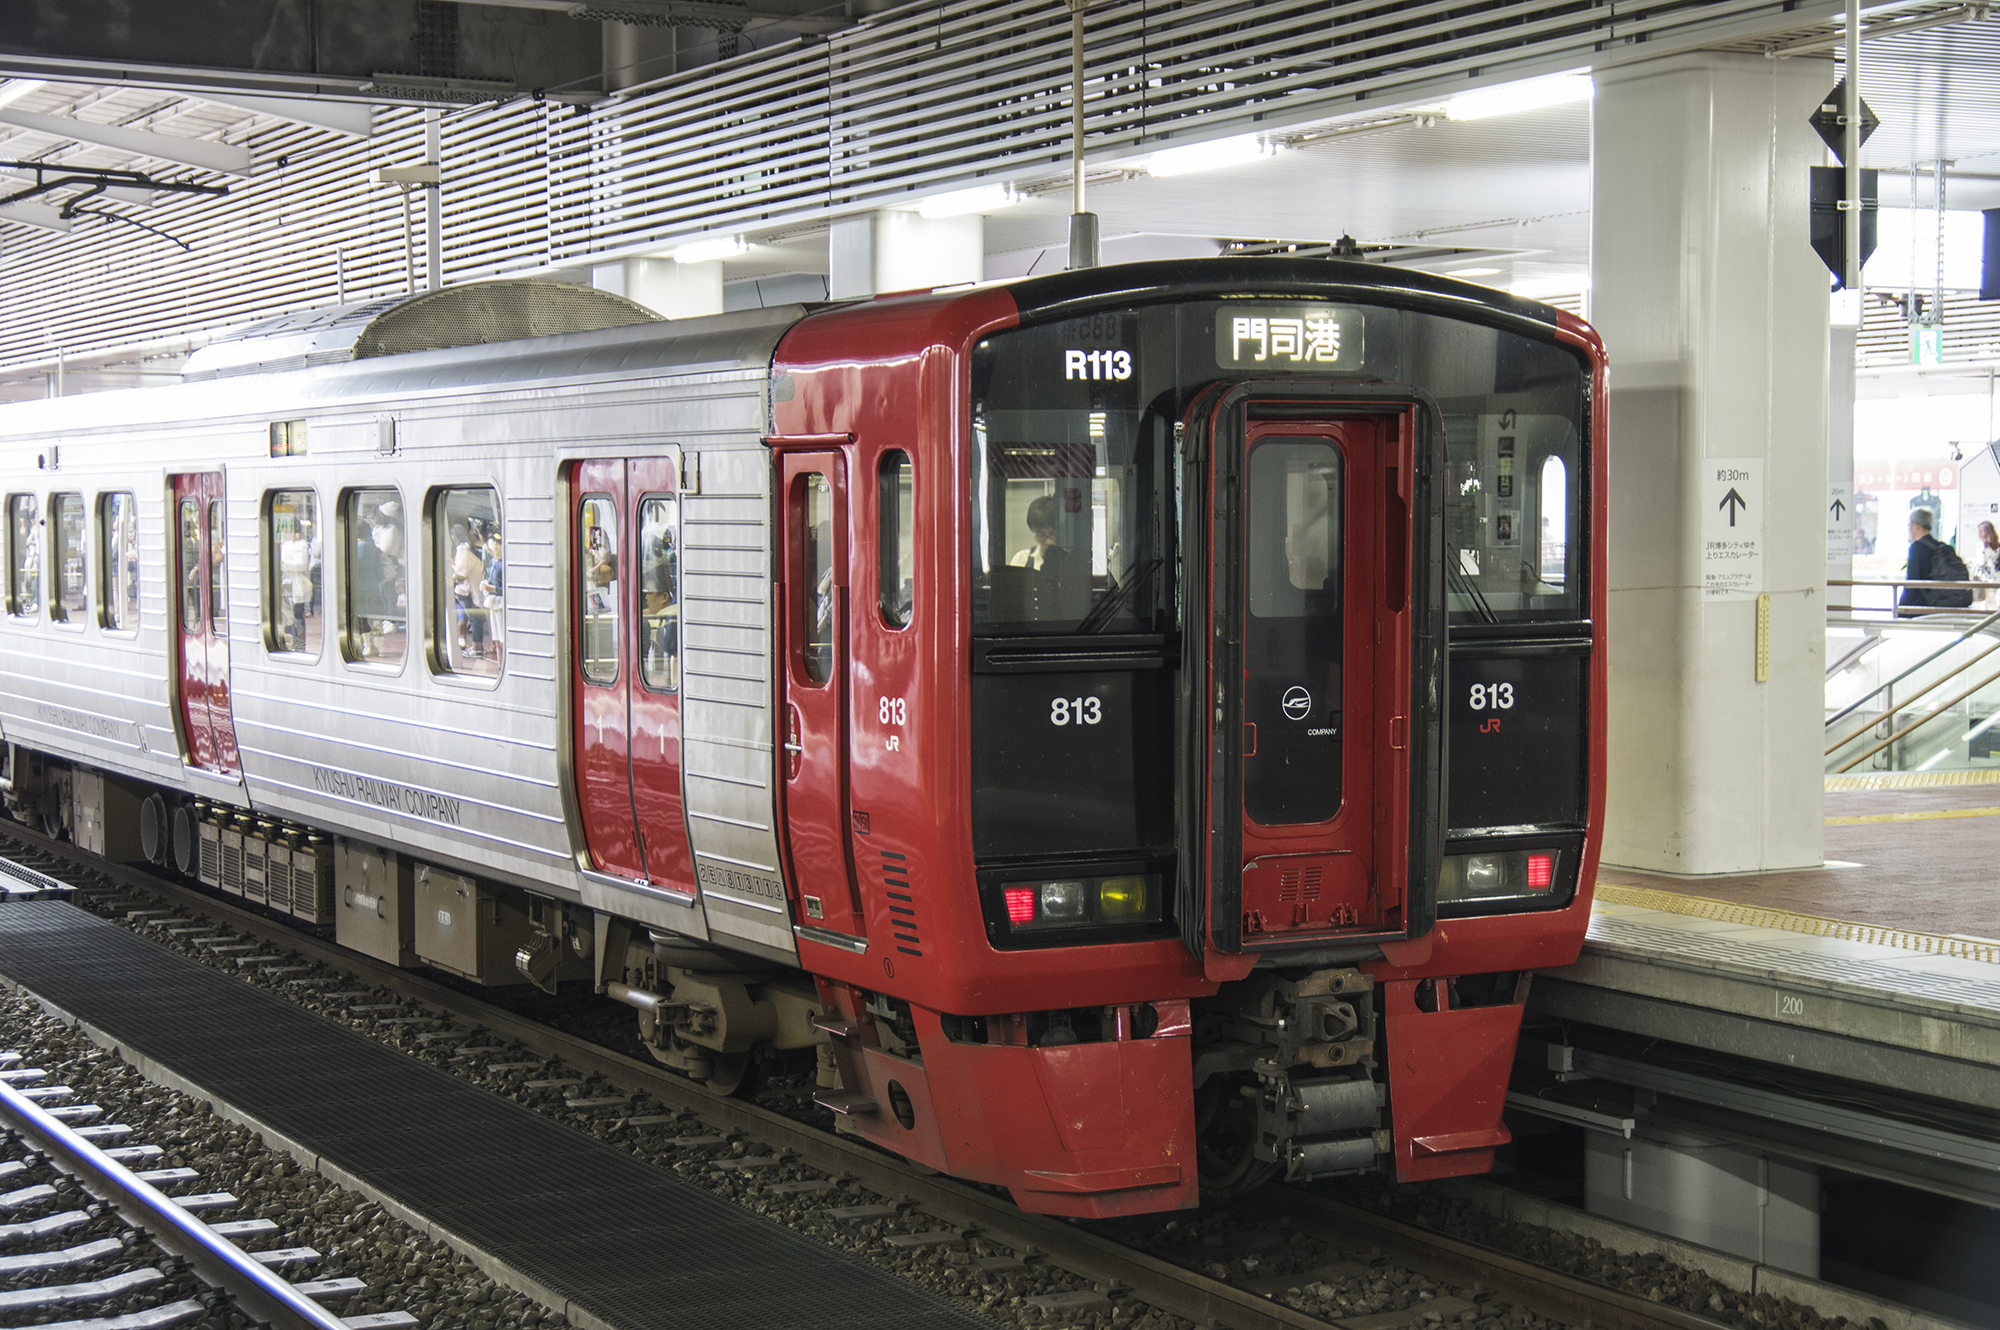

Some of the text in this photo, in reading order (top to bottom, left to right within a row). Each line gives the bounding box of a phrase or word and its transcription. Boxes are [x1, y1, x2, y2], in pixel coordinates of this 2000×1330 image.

[1233, 317, 1341, 362] 門司港
[1065, 350, 1132, 380] R113
[1716, 469, 1749, 481] 約30m
[1705, 551, 1759, 559] 上りエスカレーター
[1706, 541, 1755, 550] JR博多シティゆき
[1469, 682, 1515, 710] 813
[879, 696, 906, 726] 813
[1050, 696, 1102, 726] 813
[1307, 728, 1337, 736] COMPANY
[1480, 718, 1501, 733] JR
[886, 735, 899, 751] JR
[312, 767, 461, 825] KYUSHU RAILWAY COMPANY
[1782, 995, 1803, 1015] 200
